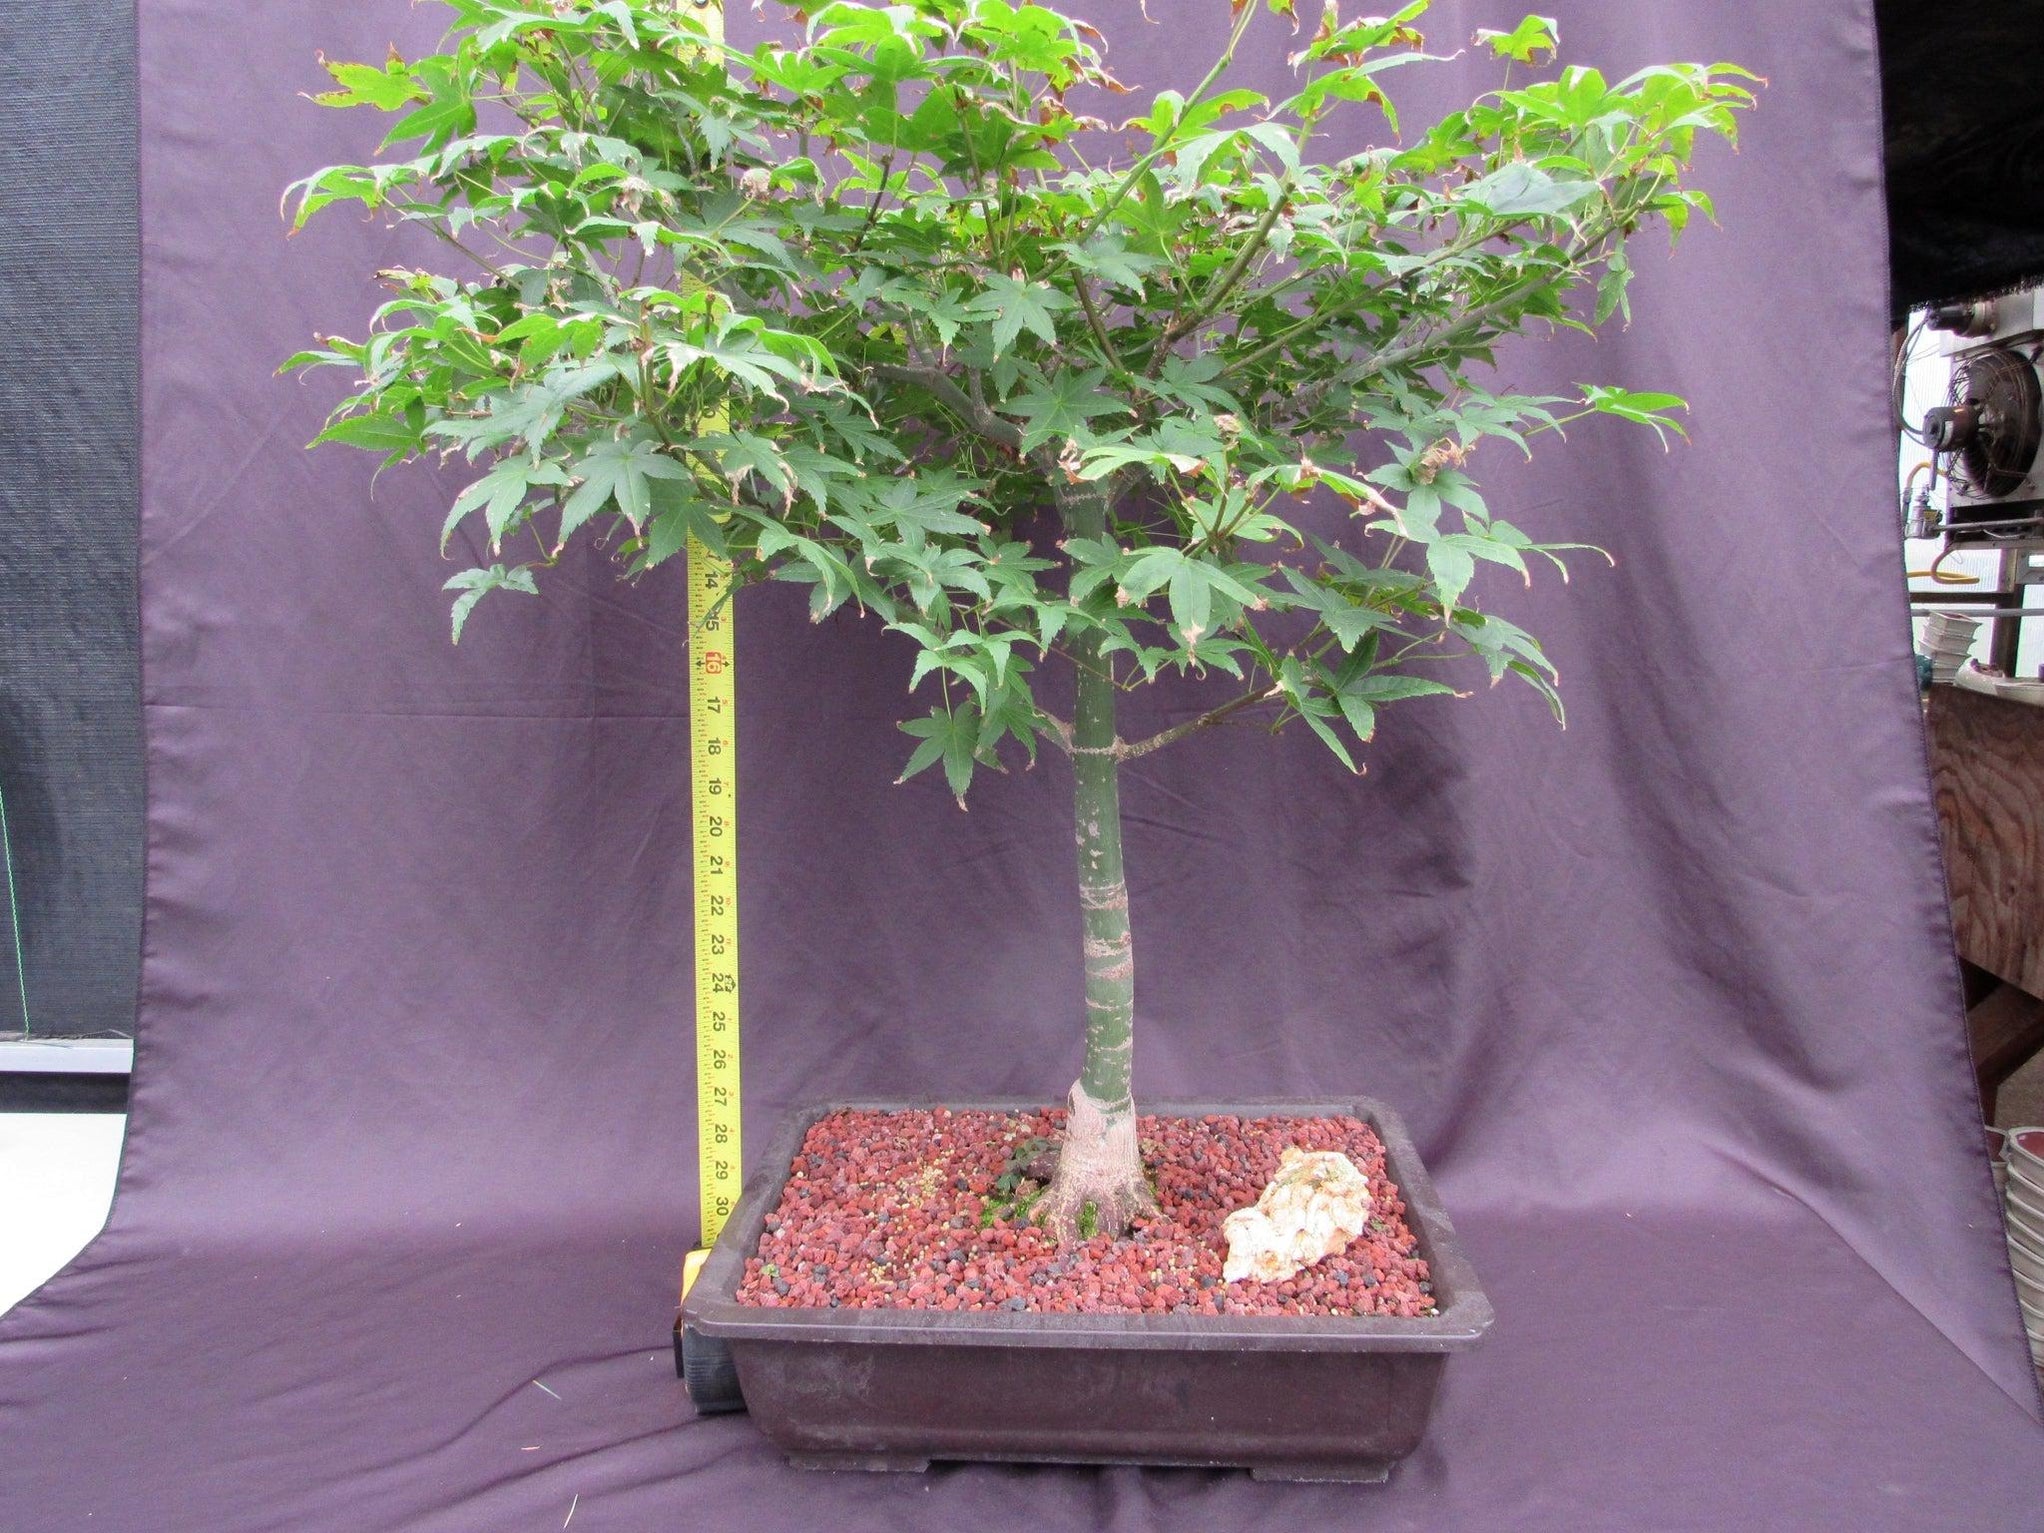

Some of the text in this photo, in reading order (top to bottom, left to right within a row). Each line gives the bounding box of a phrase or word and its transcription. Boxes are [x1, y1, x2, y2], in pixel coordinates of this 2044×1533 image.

[705, 571, 718, 589] 14
[706, 652, 721, 674] 16
[707, 696, 721, 714] 17
[708, 737, 721, 756] 18
[708, 777, 722, 795] 19
[709, 816, 723, 837] 20
[710, 856, 723, 875] 21
[711, 895, 724, 916] 22
[711, 934, 725, 955] 23
[712, 973, 724, 993] 24
[713, 1011, 726, 1032] 25
[713, 1050, 727, 1069] 26
[714, 1087, 727, 1107] 27
[715, 1124, 728, 1144] 28
[715, 1161, 728, 1180] 29
[716, 1197, 729, 1216] 30
